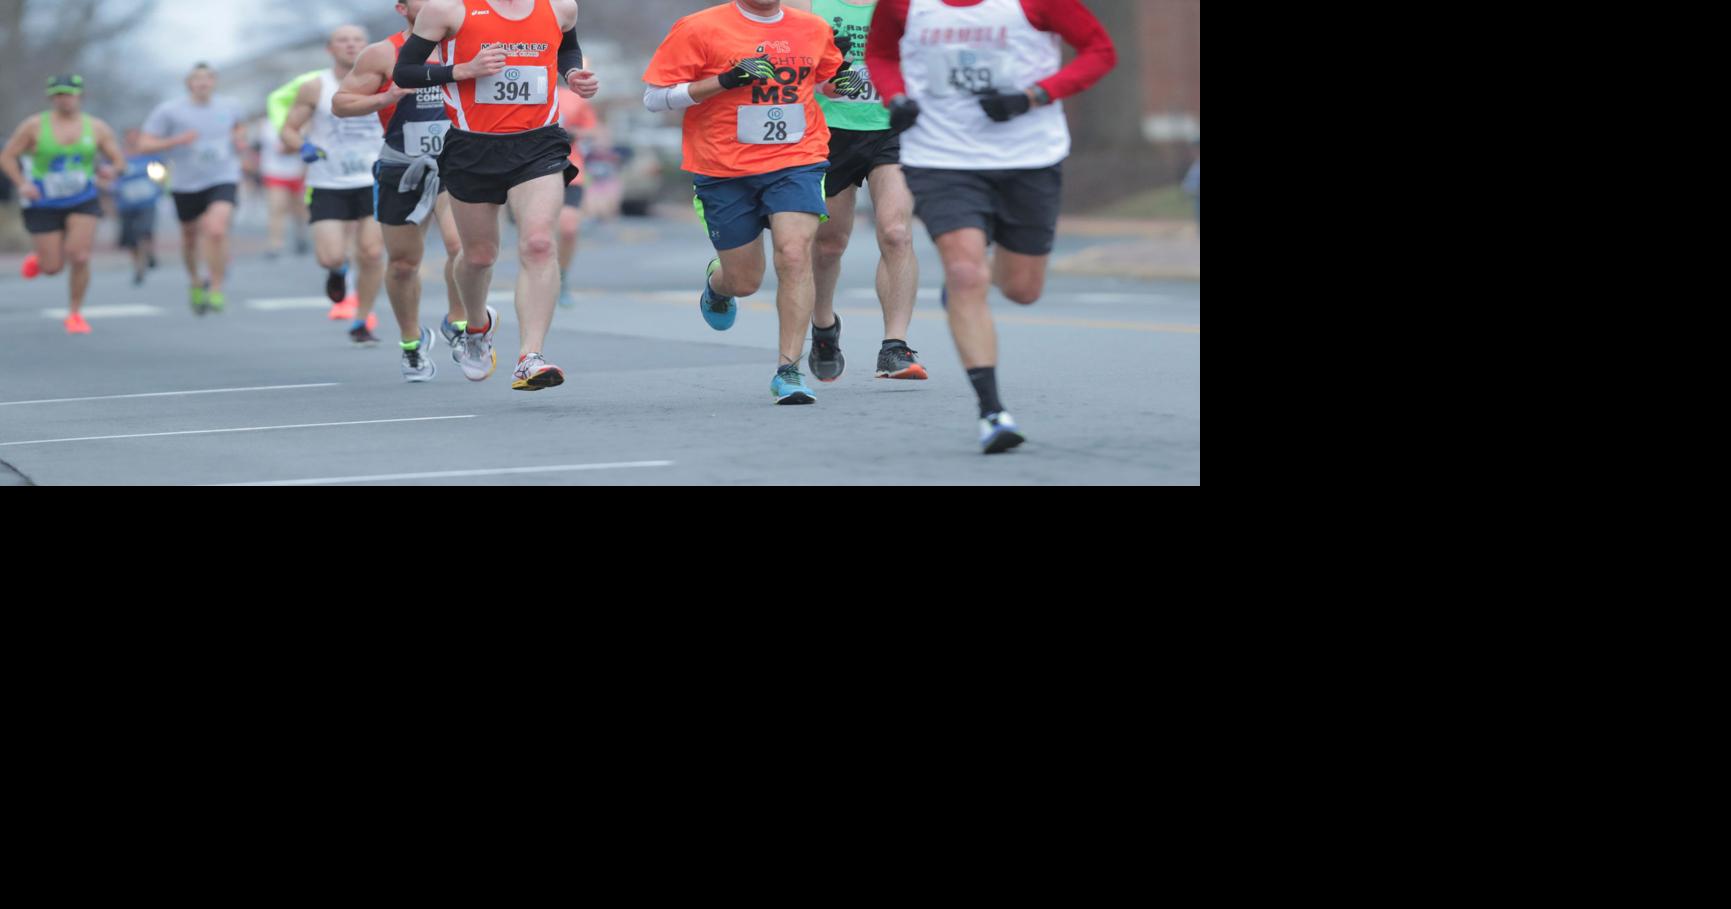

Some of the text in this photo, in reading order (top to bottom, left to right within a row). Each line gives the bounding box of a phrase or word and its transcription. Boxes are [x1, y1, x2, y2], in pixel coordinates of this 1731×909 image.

[525, 43, 548, 51] LEAF
[416, 86, 441, 94] RUN
[493, 81, 531, 101] 394
[752, 85, 799, 105] MS
[763, 121, 787, 141] 28
[420, 135, 442, 153] 50
